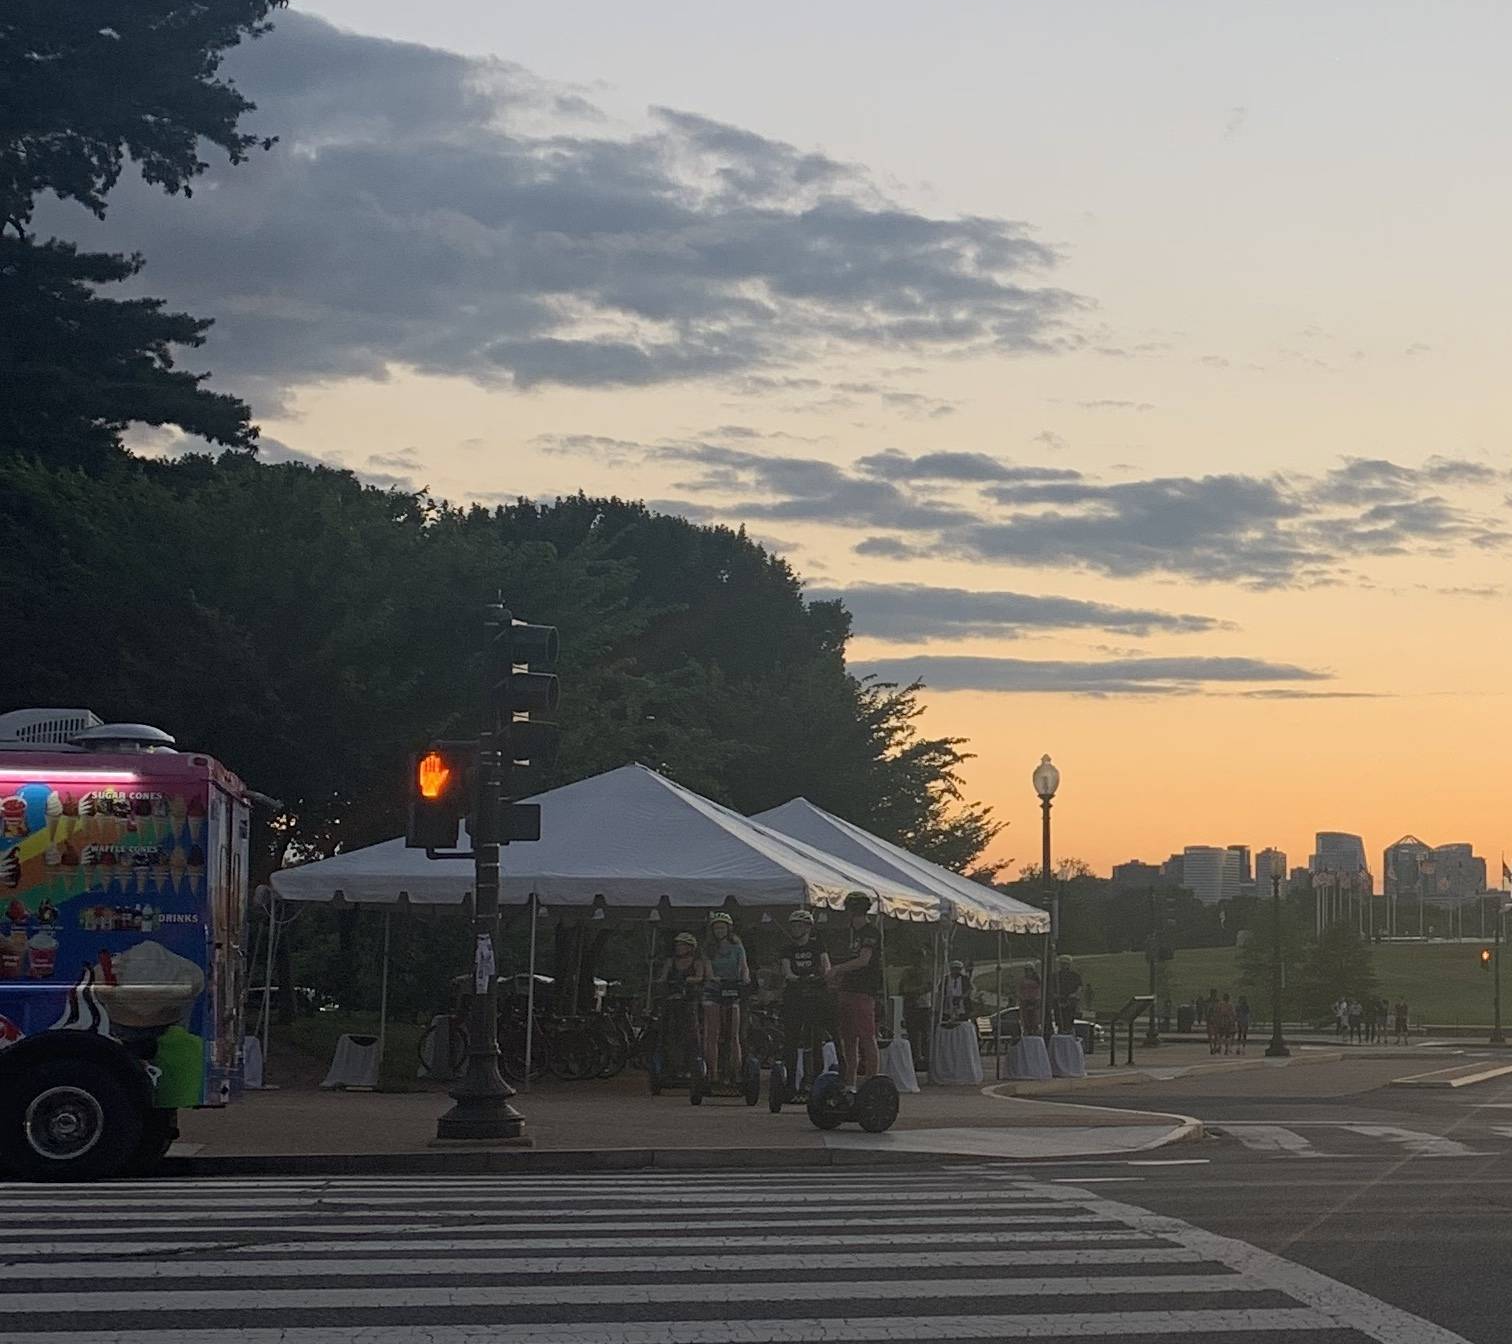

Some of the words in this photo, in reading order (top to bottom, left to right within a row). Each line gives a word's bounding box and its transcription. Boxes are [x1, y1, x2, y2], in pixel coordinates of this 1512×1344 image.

[92, 791, 126, 800] SUGAR
[129, 791, 162, 800] CONES
[158, 913, 199, 923] DRINKS
